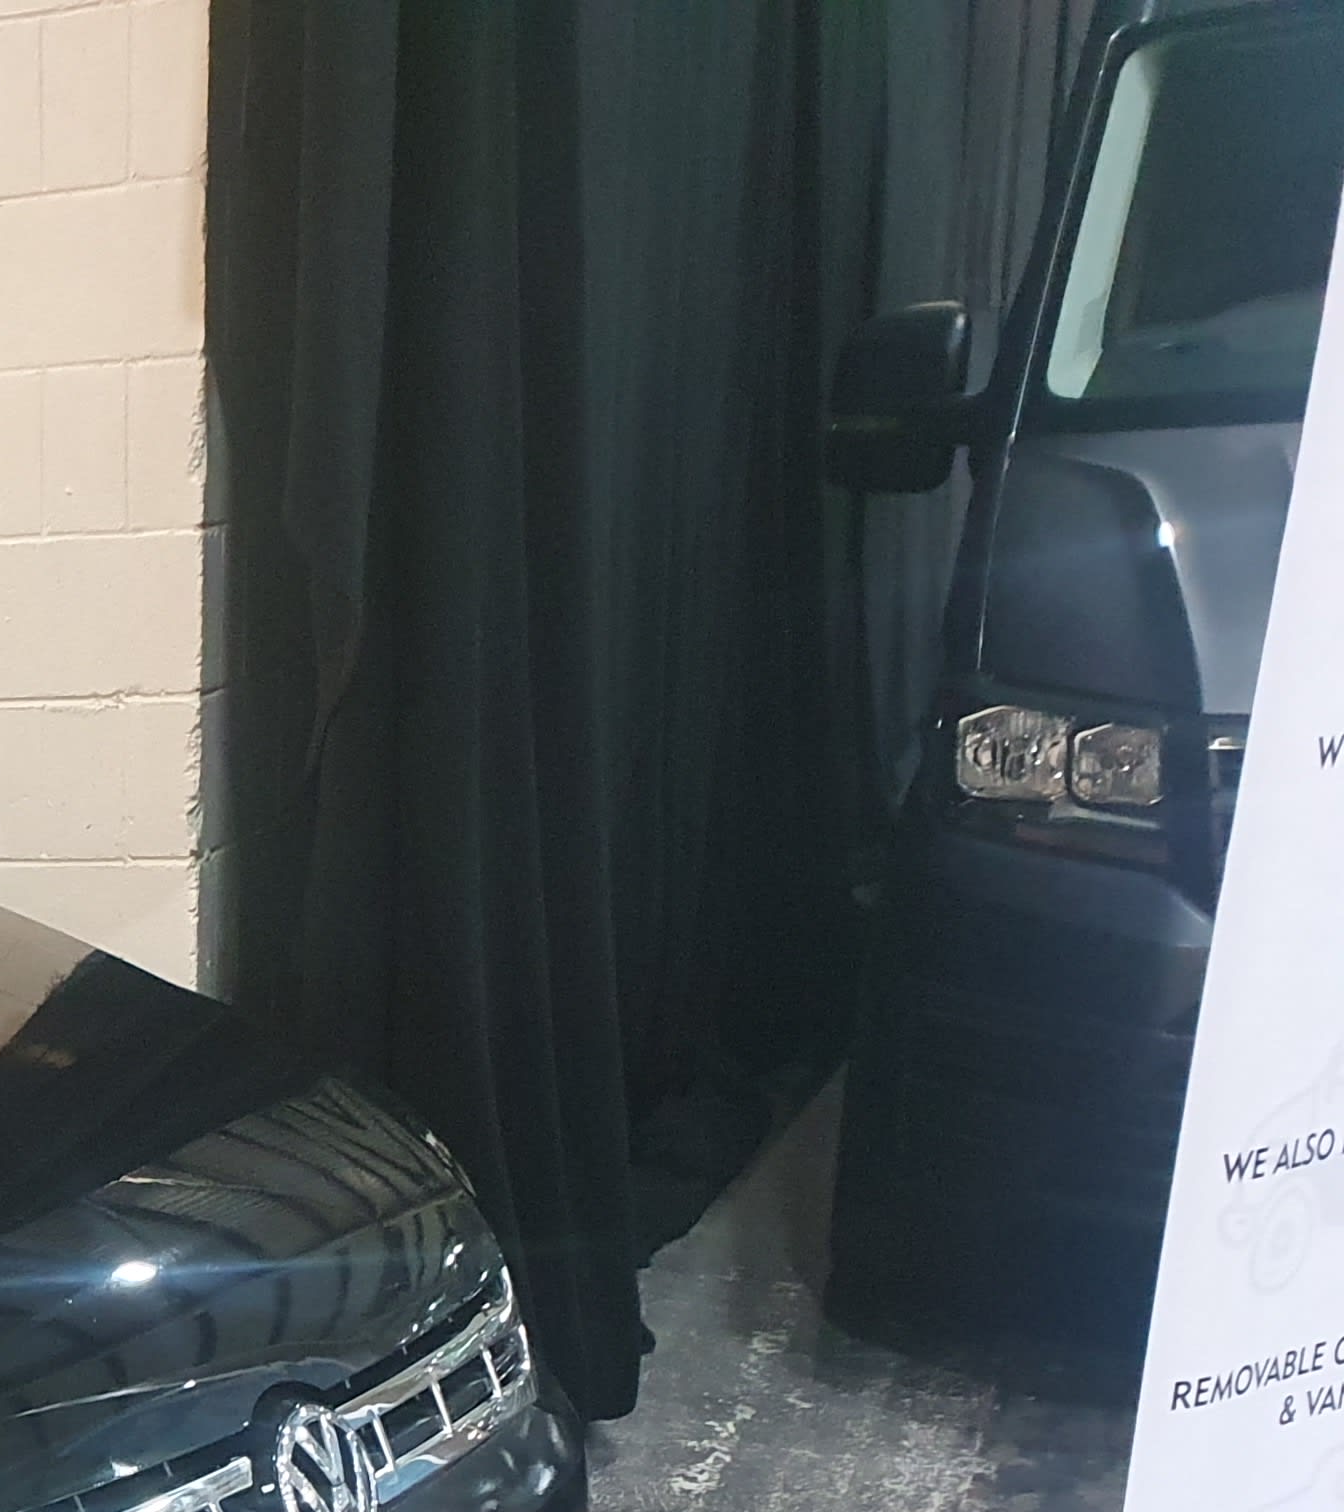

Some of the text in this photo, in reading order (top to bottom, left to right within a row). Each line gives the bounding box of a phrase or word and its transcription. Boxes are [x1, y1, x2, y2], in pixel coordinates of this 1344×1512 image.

[1223, 1128, 1335, 1184] WE ALSO
[1170, 1340, 1327, 1412] REMOVABLE
[1278, 1393, 1297, 1426] &
